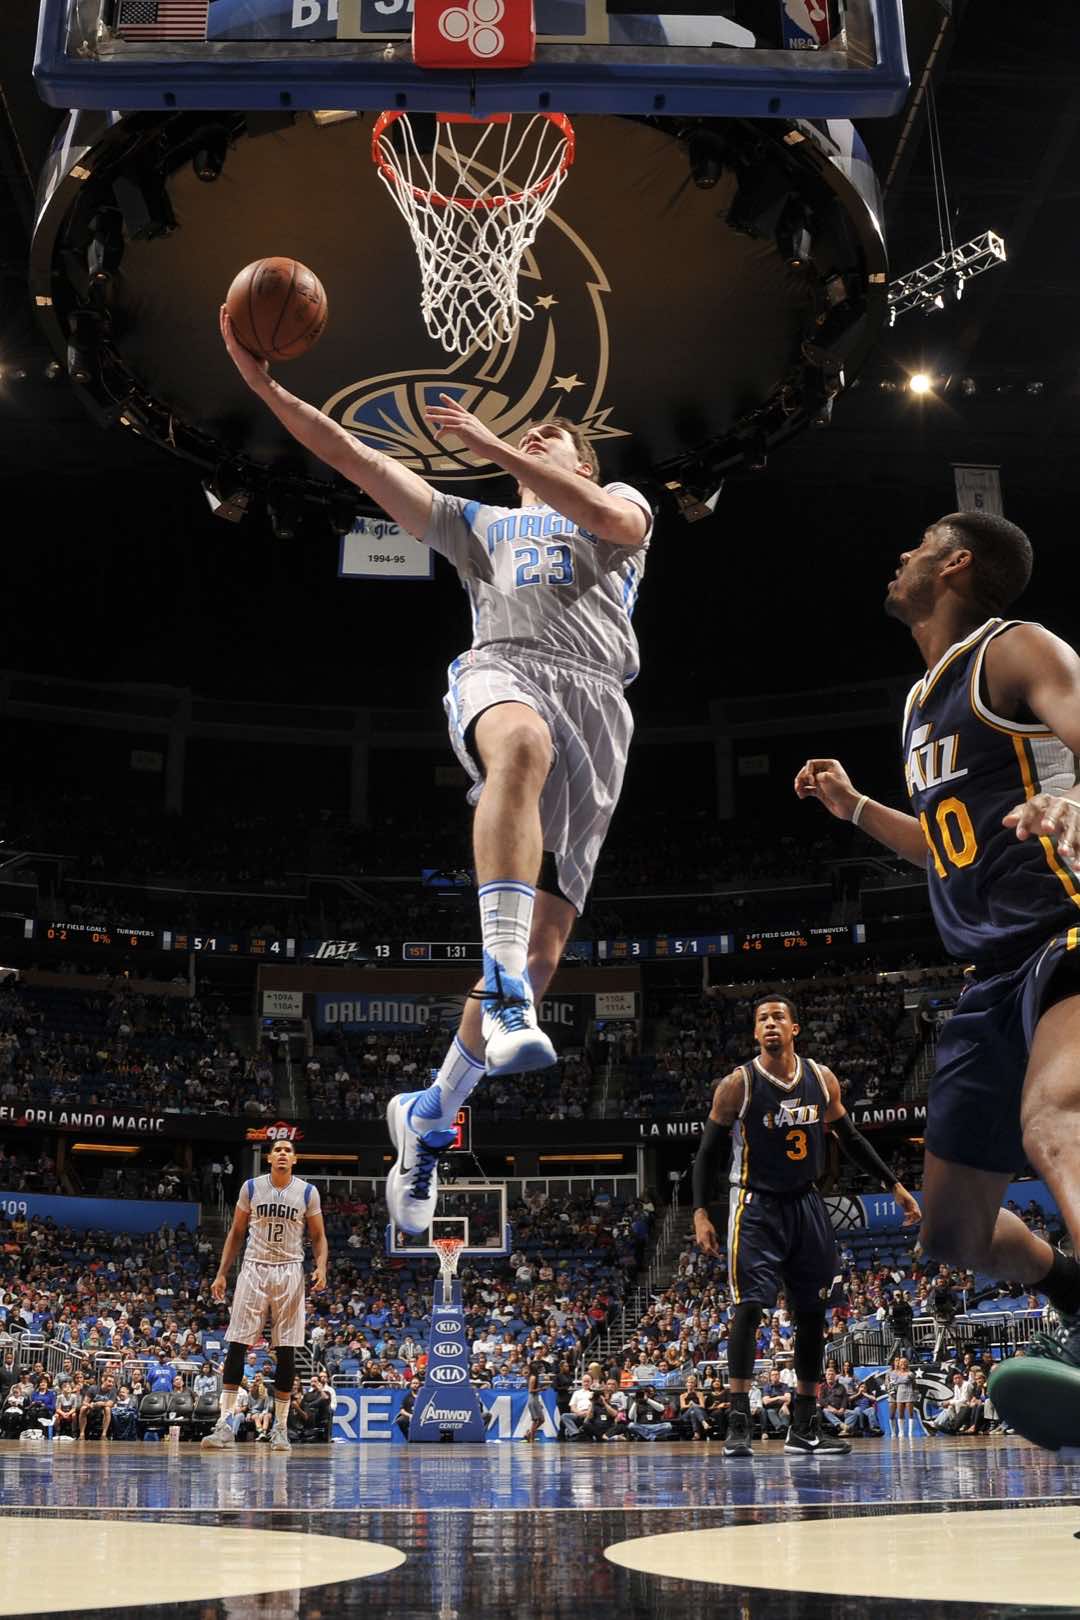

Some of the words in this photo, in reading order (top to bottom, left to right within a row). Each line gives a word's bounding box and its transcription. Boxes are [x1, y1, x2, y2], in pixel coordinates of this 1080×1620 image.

[368, 554, 406, 563] 1994-95
[515, 544, 574, 587] 23
[919, 796, 978, 879] 10
[48, 929, 67, 940] 0-2
[116, 928, 155, 937] TURNOVERS
[809, 926, 849, 935] TURNOVERS
[92, 933, 111, 944] 0%
[130, 936, 138, 946] 6
[193, 937, 217, 951] 5/1
[783, 937, 808, 948] 67%
[824, 934, 832, 944] 3
[270, 941, 281, 953] 4
[375, 945, 390, 957] 13
[410, 946, 425, 956] 1ST
[446, 945, 466, 958] 1:31
[631, 942, 640, 955] 3
[674, 940, 698, 953] 5/1
[324, 1002, 430, 1025] ORLANDO
[538, 1001, 575, 1026] GIC
[25, 1108, 105, 1127] ORLANDO
[112, 1115, 166, 1132] MAGIC
[639, 1123, 660, 1137] LA
[852, 1107, 908, 1124] LANDO
[785, 1129, 808, 1161] 3
[256, 1203, 299, 1222] MAGIC
[873, 1200, 896, 1217] 111
[267, 1222, 284, 1243] 12
[440, 1323, 457, 1332] KIA
[438, 1344, 458, 1354] KIA
[436, 1369, 461, 1380] KIA
[332, 1395, 392, 1439] RE
[425, 1406, 472, 1423] Amway
[438, 1422, 464, 1430] CENTER
